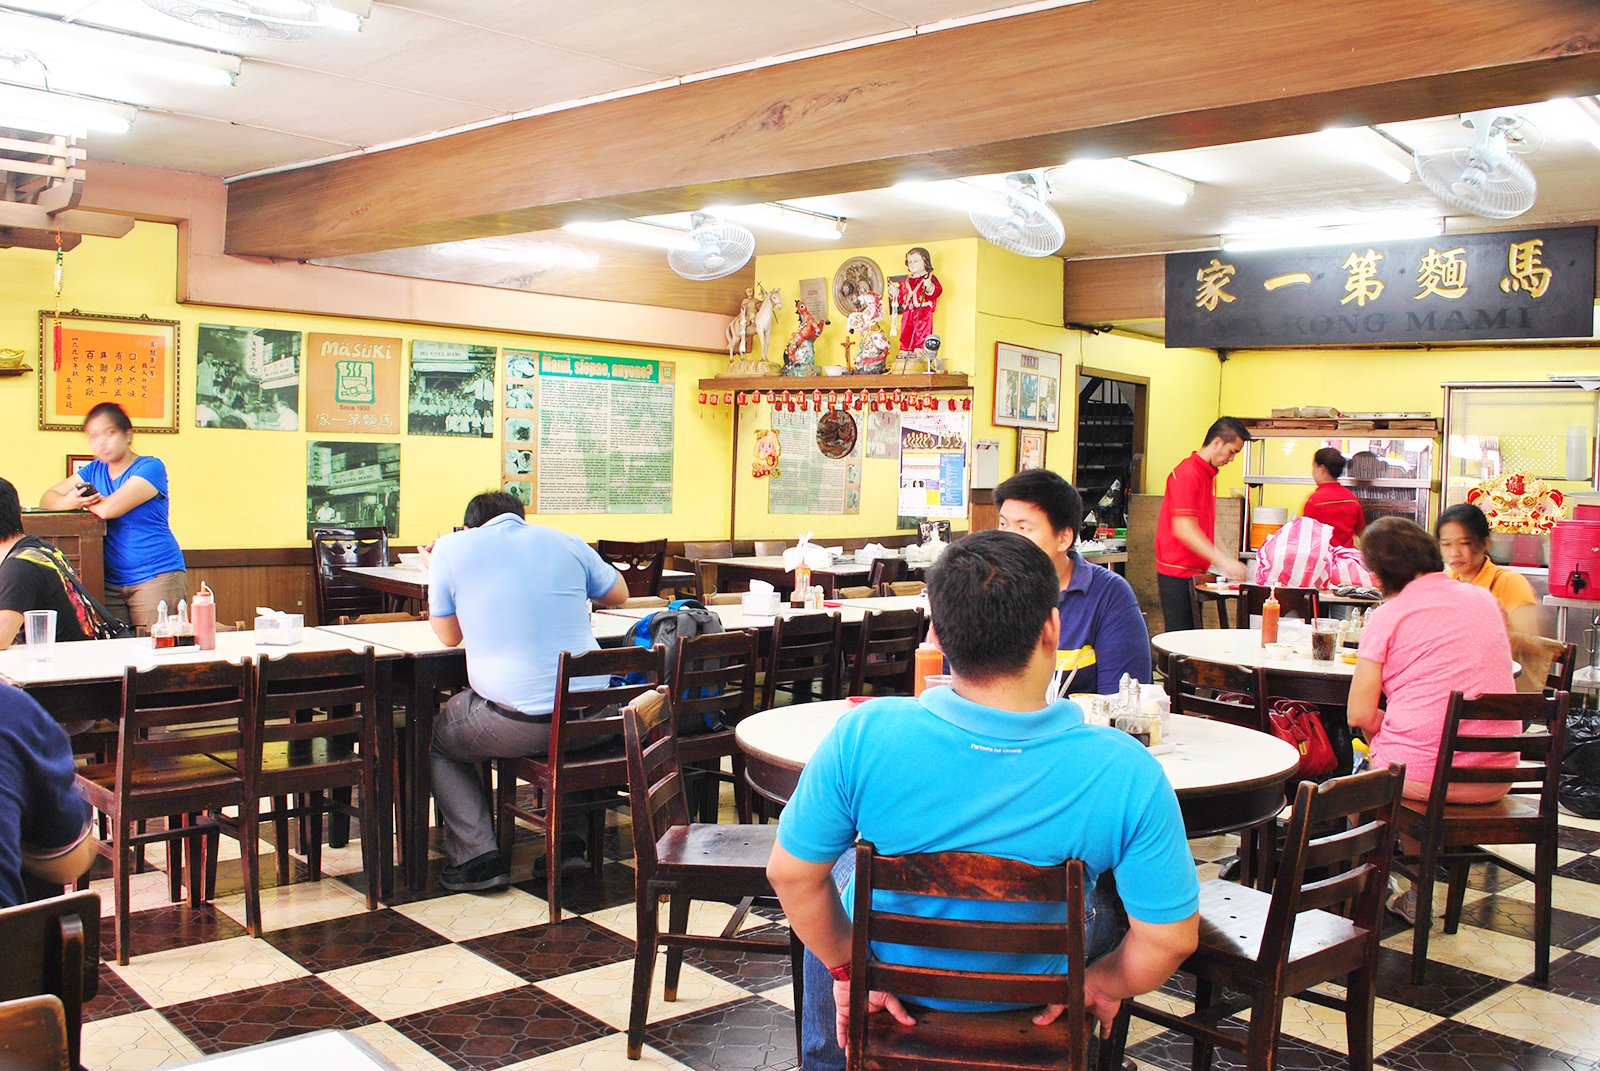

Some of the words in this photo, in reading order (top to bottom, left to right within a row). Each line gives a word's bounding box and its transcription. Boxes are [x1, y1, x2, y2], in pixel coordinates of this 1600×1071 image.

[1286, 311, 1388, 337] KONG
[1404, 307, 1535, 332] MAMI
[541, 356, 573, 375] Mami,
[574, 359, 610, 378] siopao,
[611, 363, 653, 380] anyone?
